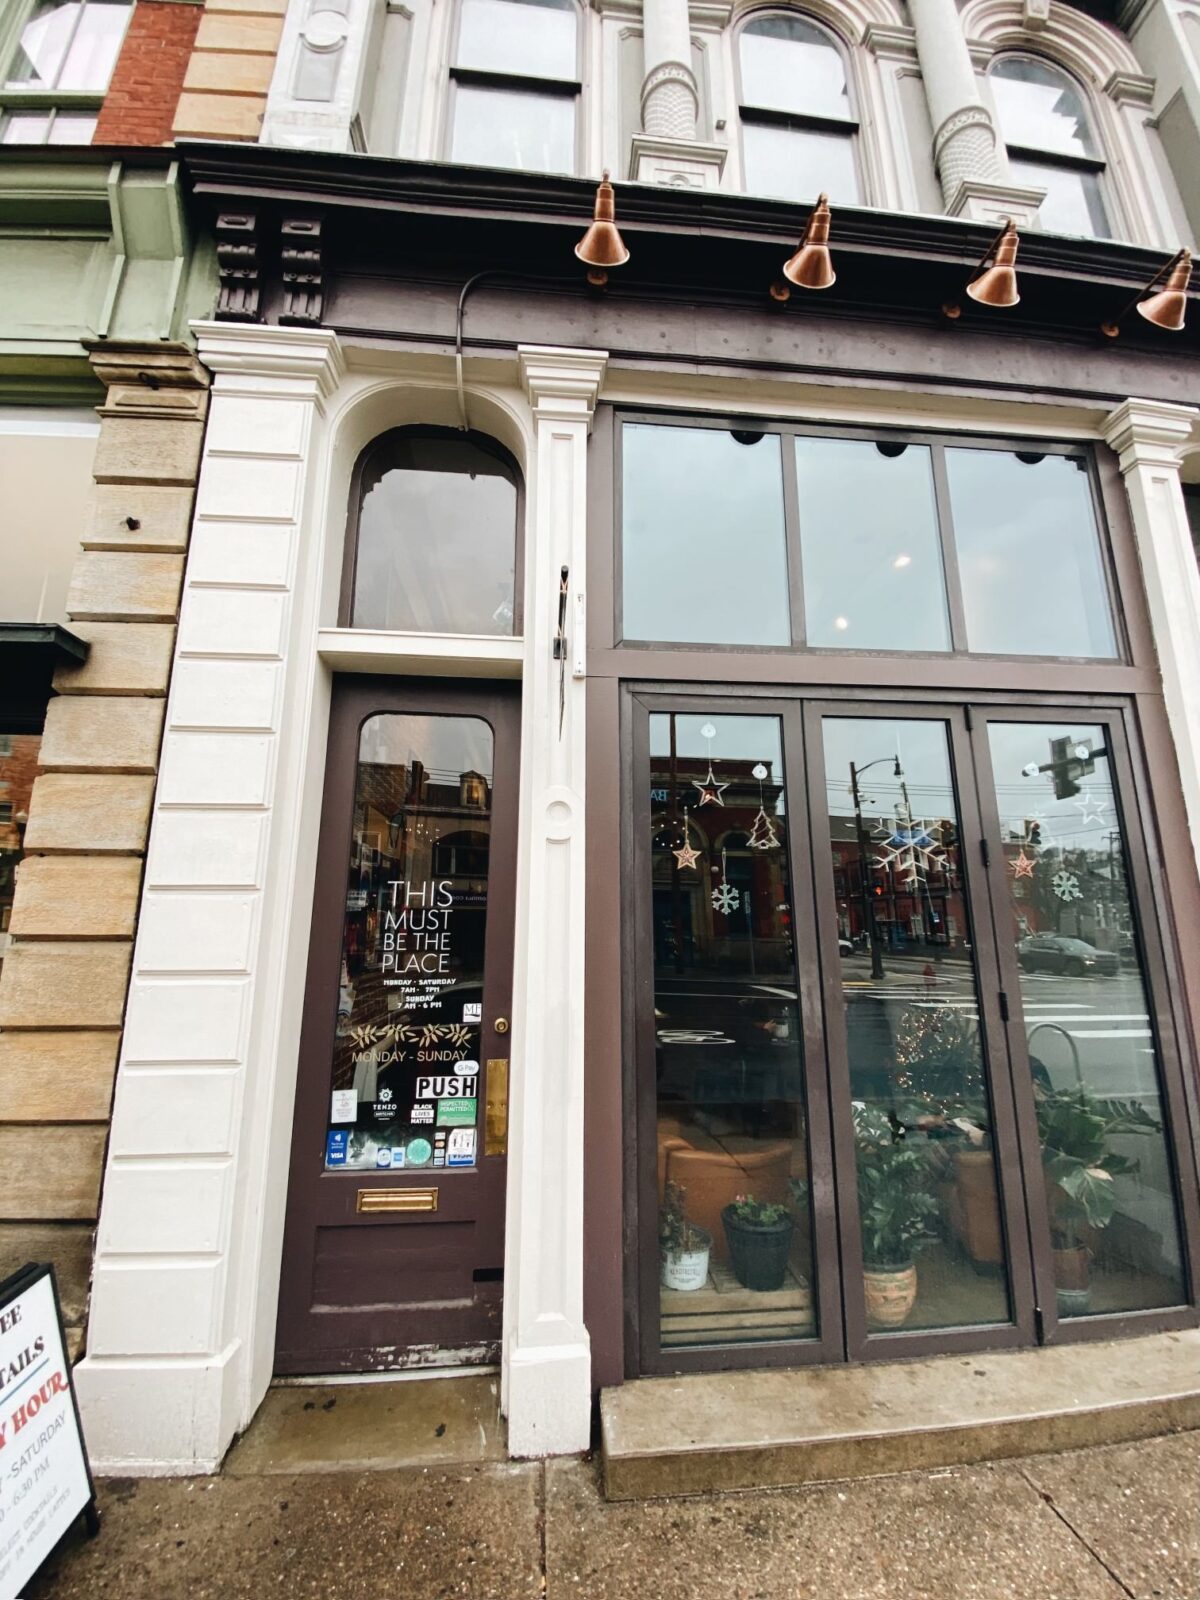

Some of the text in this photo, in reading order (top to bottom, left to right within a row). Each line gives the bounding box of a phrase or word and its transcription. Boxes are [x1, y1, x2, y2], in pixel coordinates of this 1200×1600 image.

[387, 880, 453, 907] THIS
[384, 910, 453, 930] MUST
[383, 932, 451, 951] BE THE
[381, 953, 450, 973] PLACE
[418, 978, 457, 986] SATURDAY
[405, 994, 435, 1002] SUNDAY
[351, 1051, 407, 1063] MONDAY
[416, 1050, 468, 1062] SUNDAY
[418, 1077, 475, 1098] PUSH
[11, 1370, 69, 1435] HOUR
